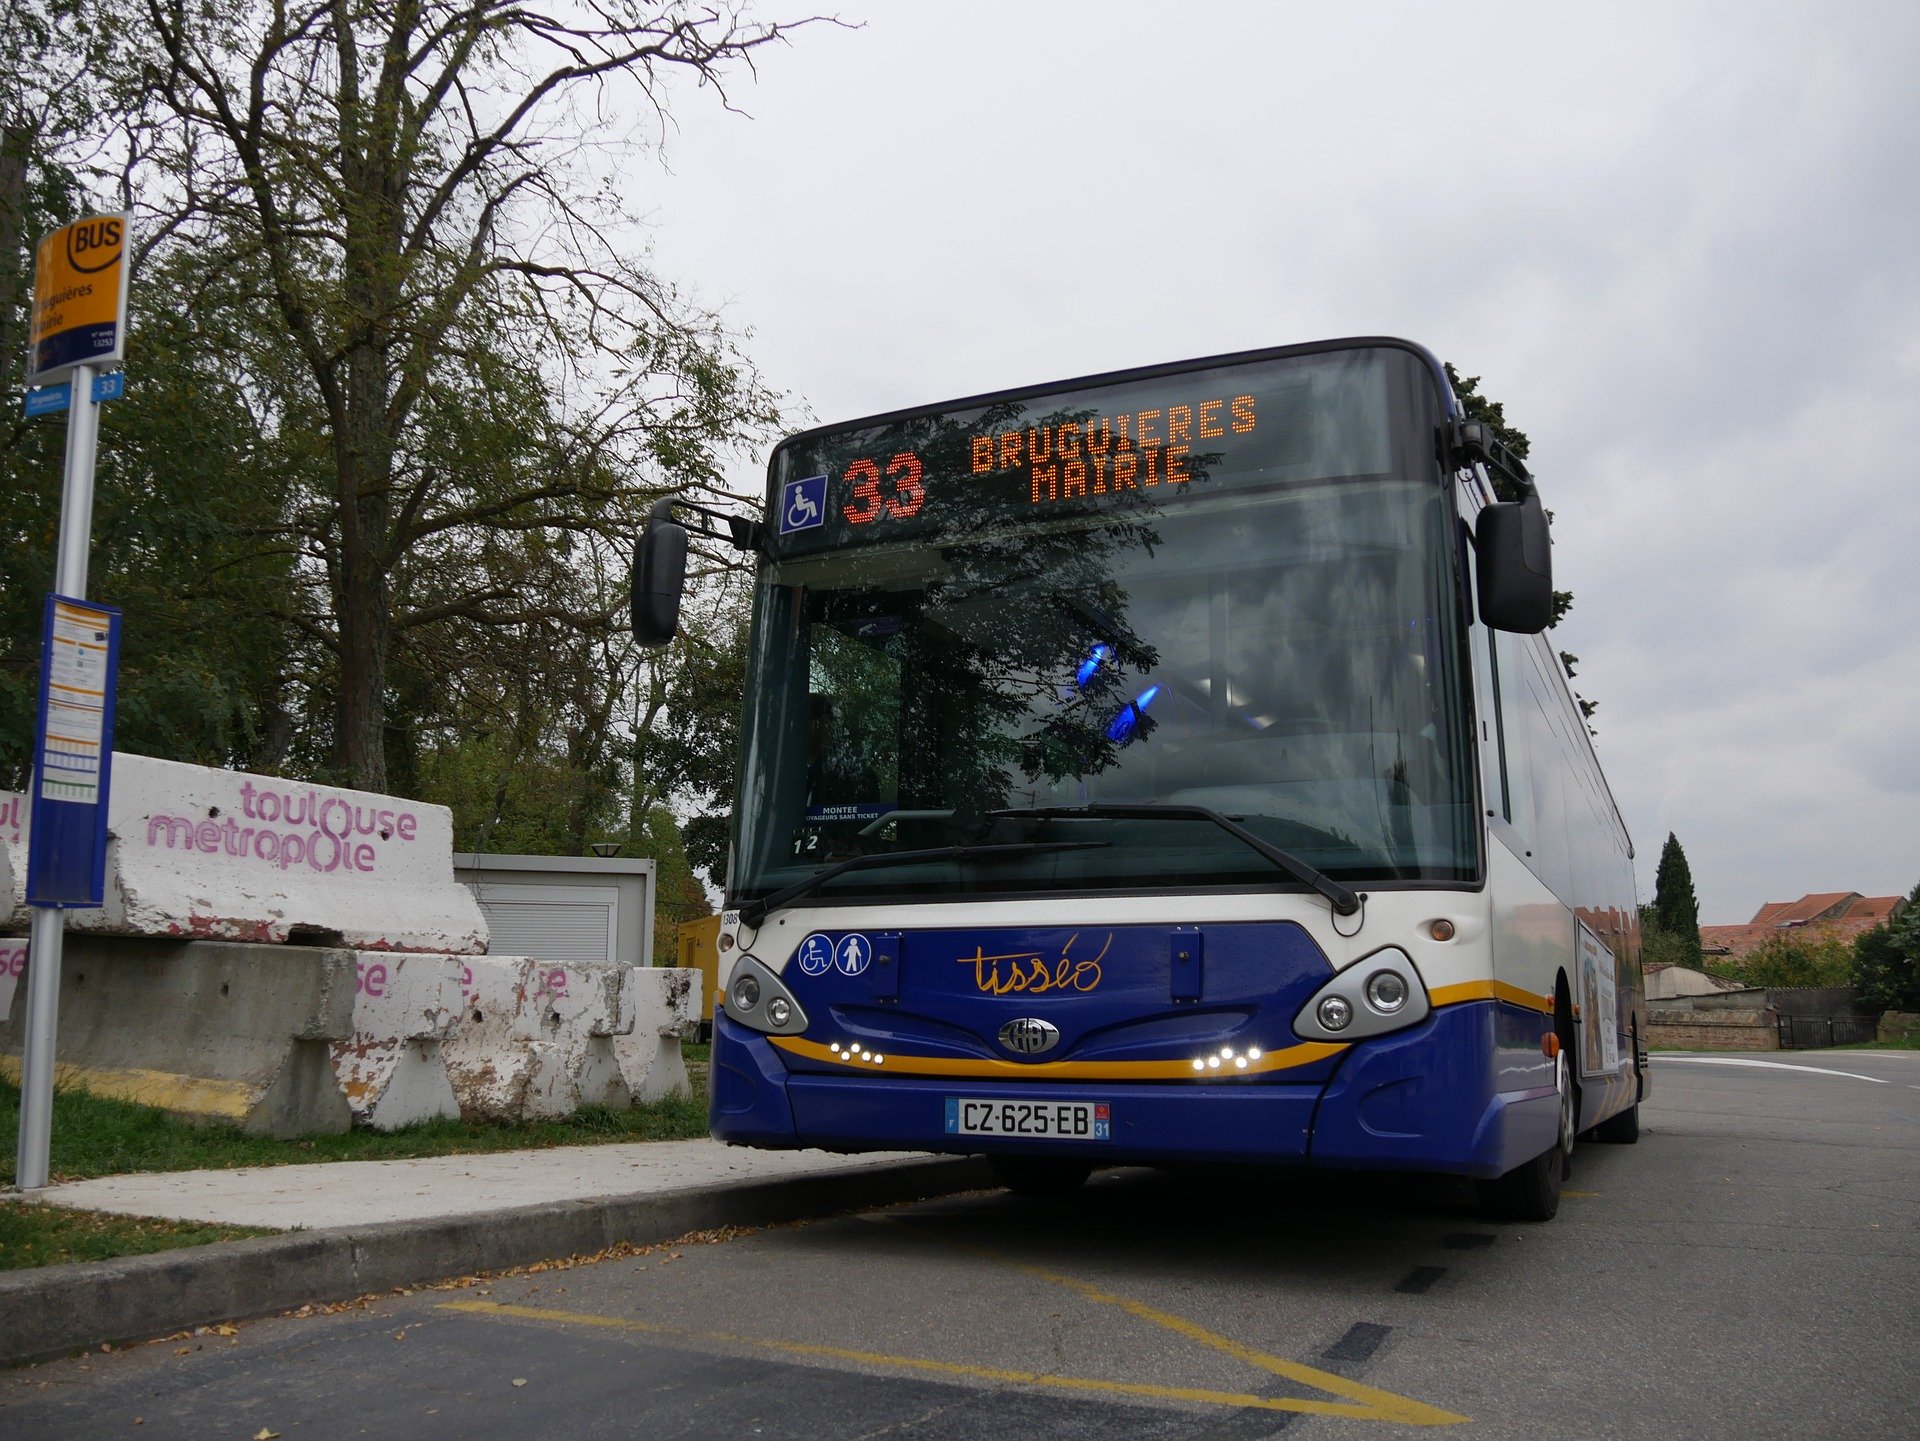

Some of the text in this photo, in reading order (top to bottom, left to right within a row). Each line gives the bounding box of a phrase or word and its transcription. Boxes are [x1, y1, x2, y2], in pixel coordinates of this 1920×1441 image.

[75, 221, 121, 253] BUS
[100, 380, 116, 395] 33
[971, 395, 1256, 474] BRUGUIERES
[842, 451, 925, 524] 33
[1032, 445, 1191, 503] MAIRIE
[240, 781, 417, 841] toulouse
[805, 812, 879, 822] OYAGEURS SANS TICKET
[823, 806, 858, 815] MONTEE
[957, 932, 1113, 996] tisséo
[964, 1103, 1089, 1135] CZ-625-EB
[1095, 1122, 1110, 1137] 31
